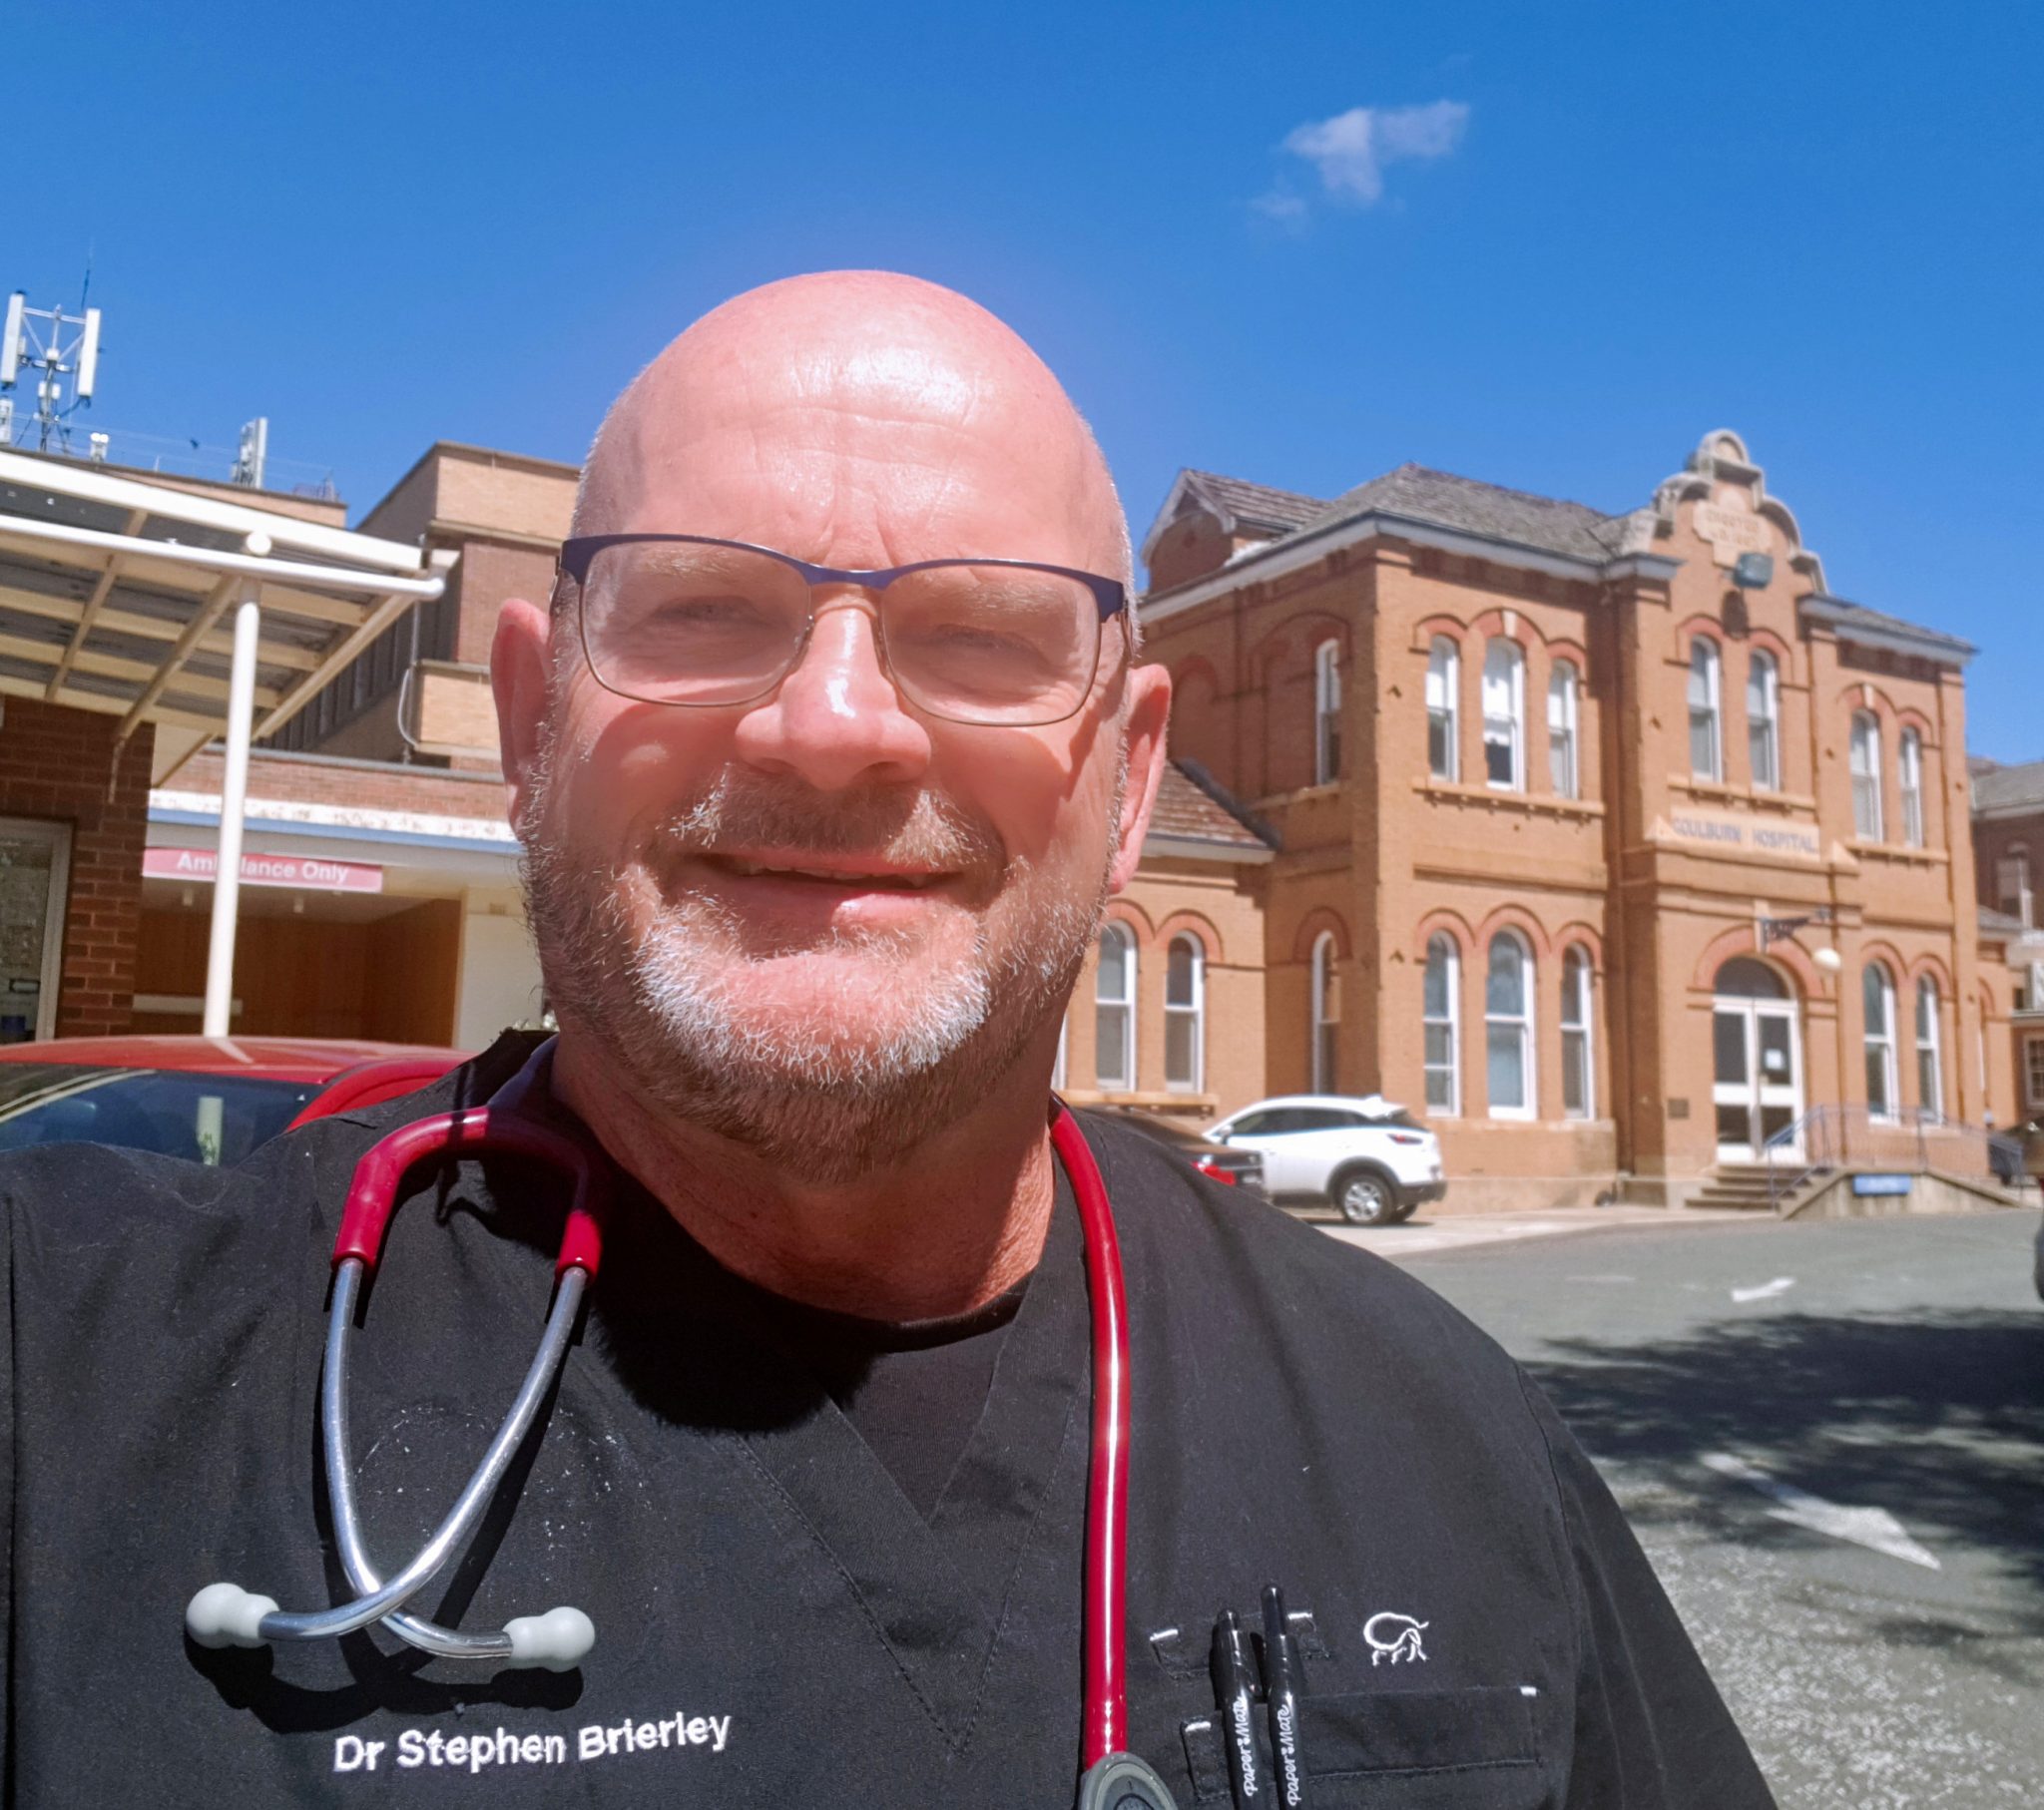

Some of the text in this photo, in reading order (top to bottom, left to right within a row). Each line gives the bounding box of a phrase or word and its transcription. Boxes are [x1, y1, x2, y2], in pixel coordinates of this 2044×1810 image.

[1672, 818, 1817, 852] GOULBURN HOSPITAL
[177, 852, 349, 884] Amlance Only
[333, 1711, 732, 1773] Dr Stephen Brierley
